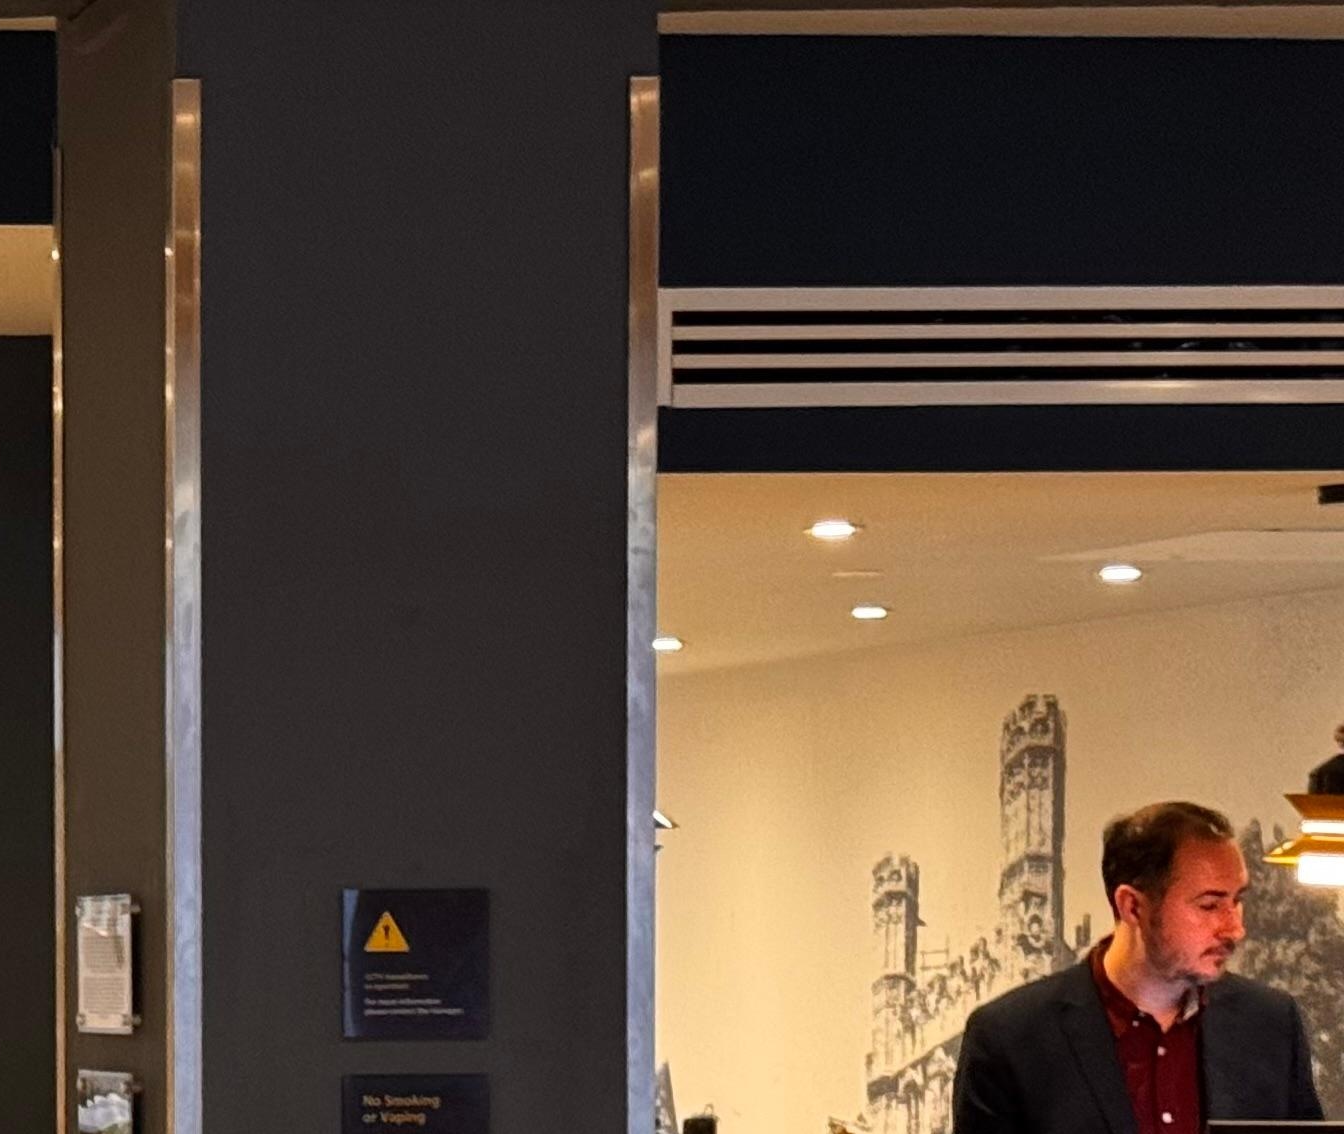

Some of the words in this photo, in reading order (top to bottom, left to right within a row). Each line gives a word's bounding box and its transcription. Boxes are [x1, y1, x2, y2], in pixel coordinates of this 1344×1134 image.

[362, 1095, 382, 1106] No
[384, 1095, 441, 1110] Smoking
[362, 1113, 378, 1123] or
[379, 1111, 427, 1127] Vaping
